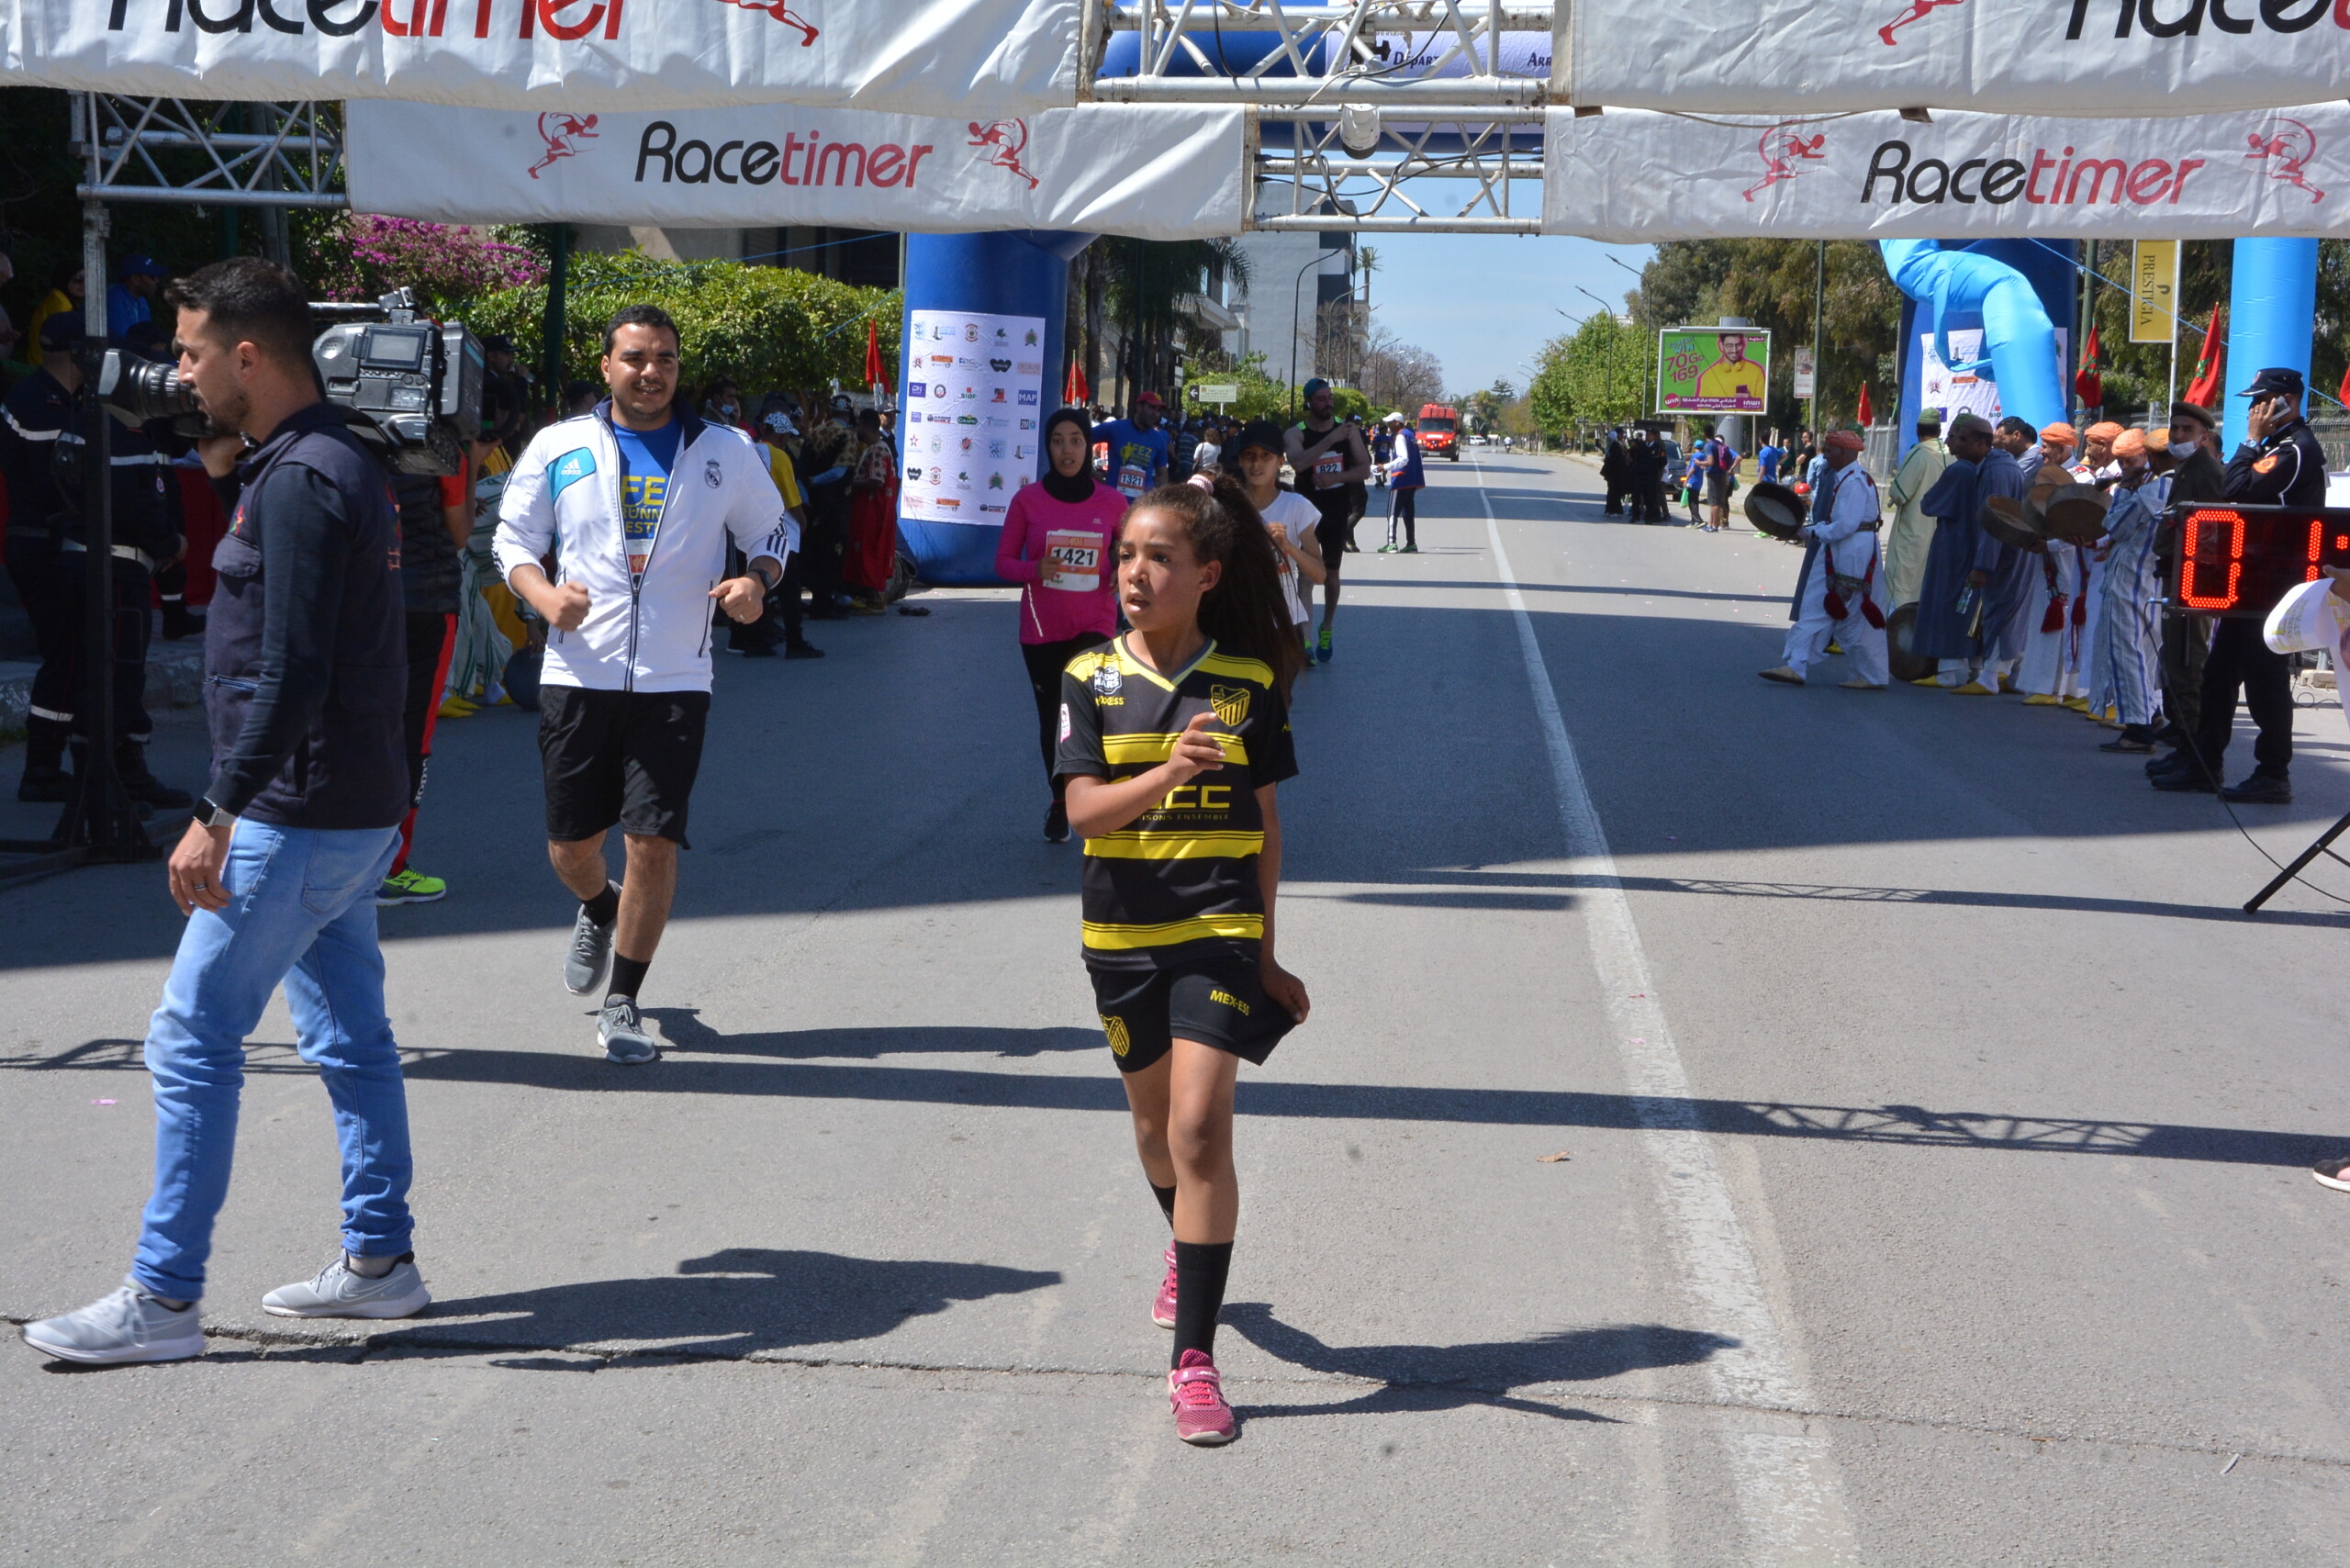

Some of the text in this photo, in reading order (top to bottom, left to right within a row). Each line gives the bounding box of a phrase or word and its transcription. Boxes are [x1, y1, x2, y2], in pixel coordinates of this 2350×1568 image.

[635, 120, 933, 188] Racetimer
[1860, 140, 2205, 205] Racetimer
[2141, 255, 2155, 326] PRESTIGIA
[1671, 365, 1698, 383] 169
[1018, 393, 1036, 402] MAP
[1319, 463, 1338, 474] 822
[1122, 474, 1142, 487] 1321
[1053, 547, 1095, 566] 1421
